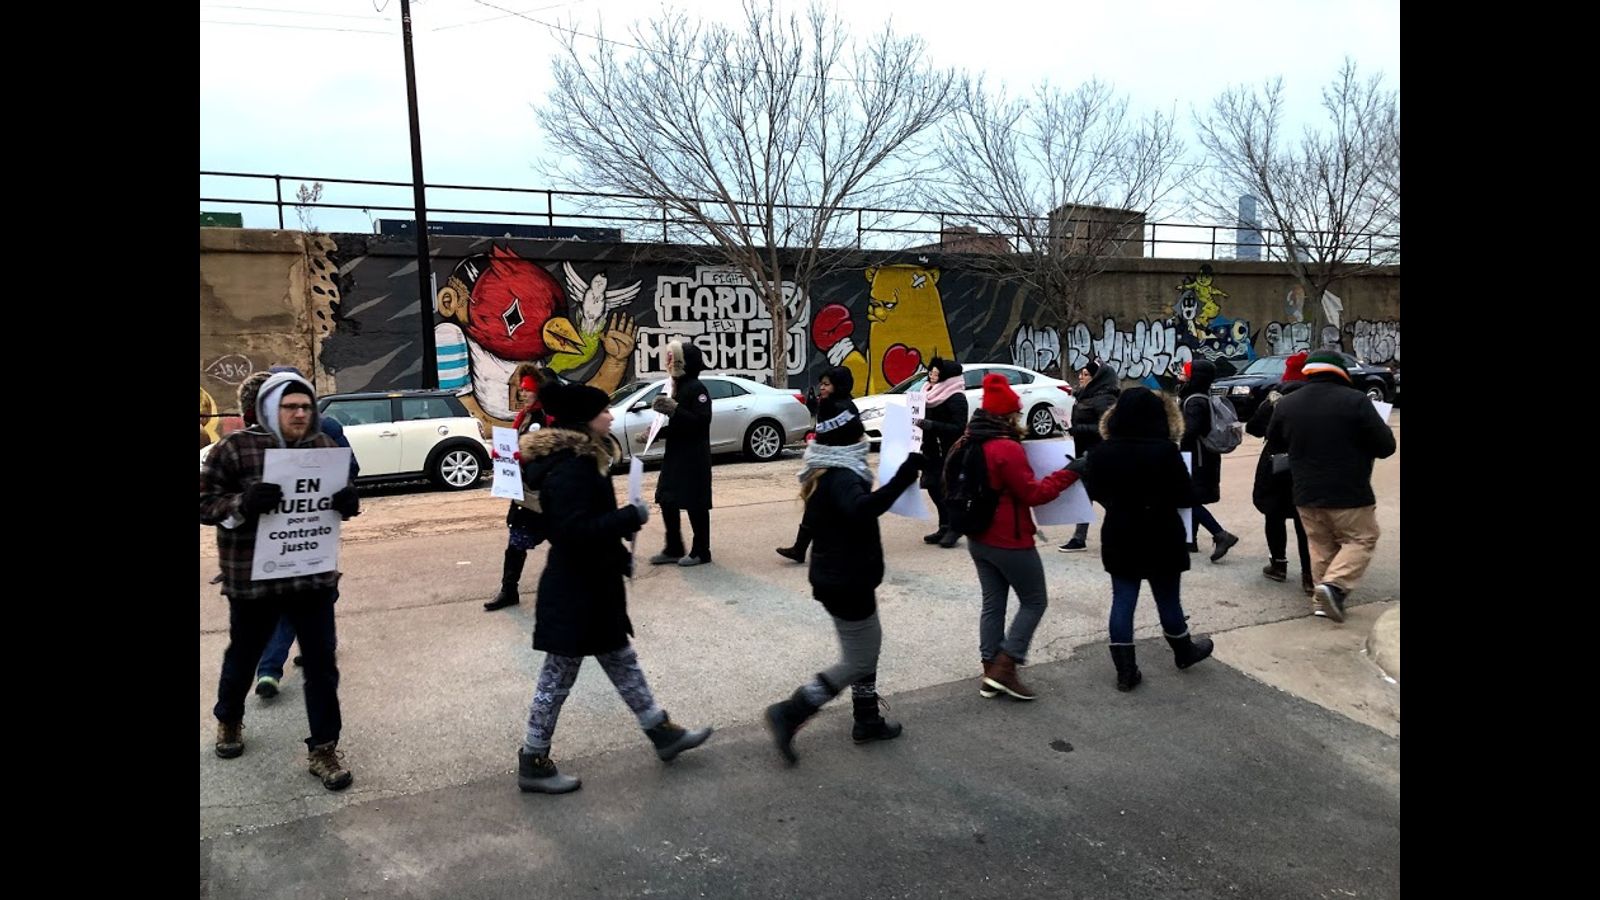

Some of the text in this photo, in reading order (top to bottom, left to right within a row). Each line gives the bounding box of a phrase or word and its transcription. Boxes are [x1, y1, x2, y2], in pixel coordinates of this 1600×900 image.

[712, 274, 745, 284] FIGHT
[713, 321, 737, 332] FLY
[638, 330, 801, 372] HGHER
[295, 478, 321, 494] EN
[267, 496, 333, 515] UELG
[287, 515, 320, 526] por un
[269, 526, 332, 540] contrato
[279, 541, 319, 556] justo
